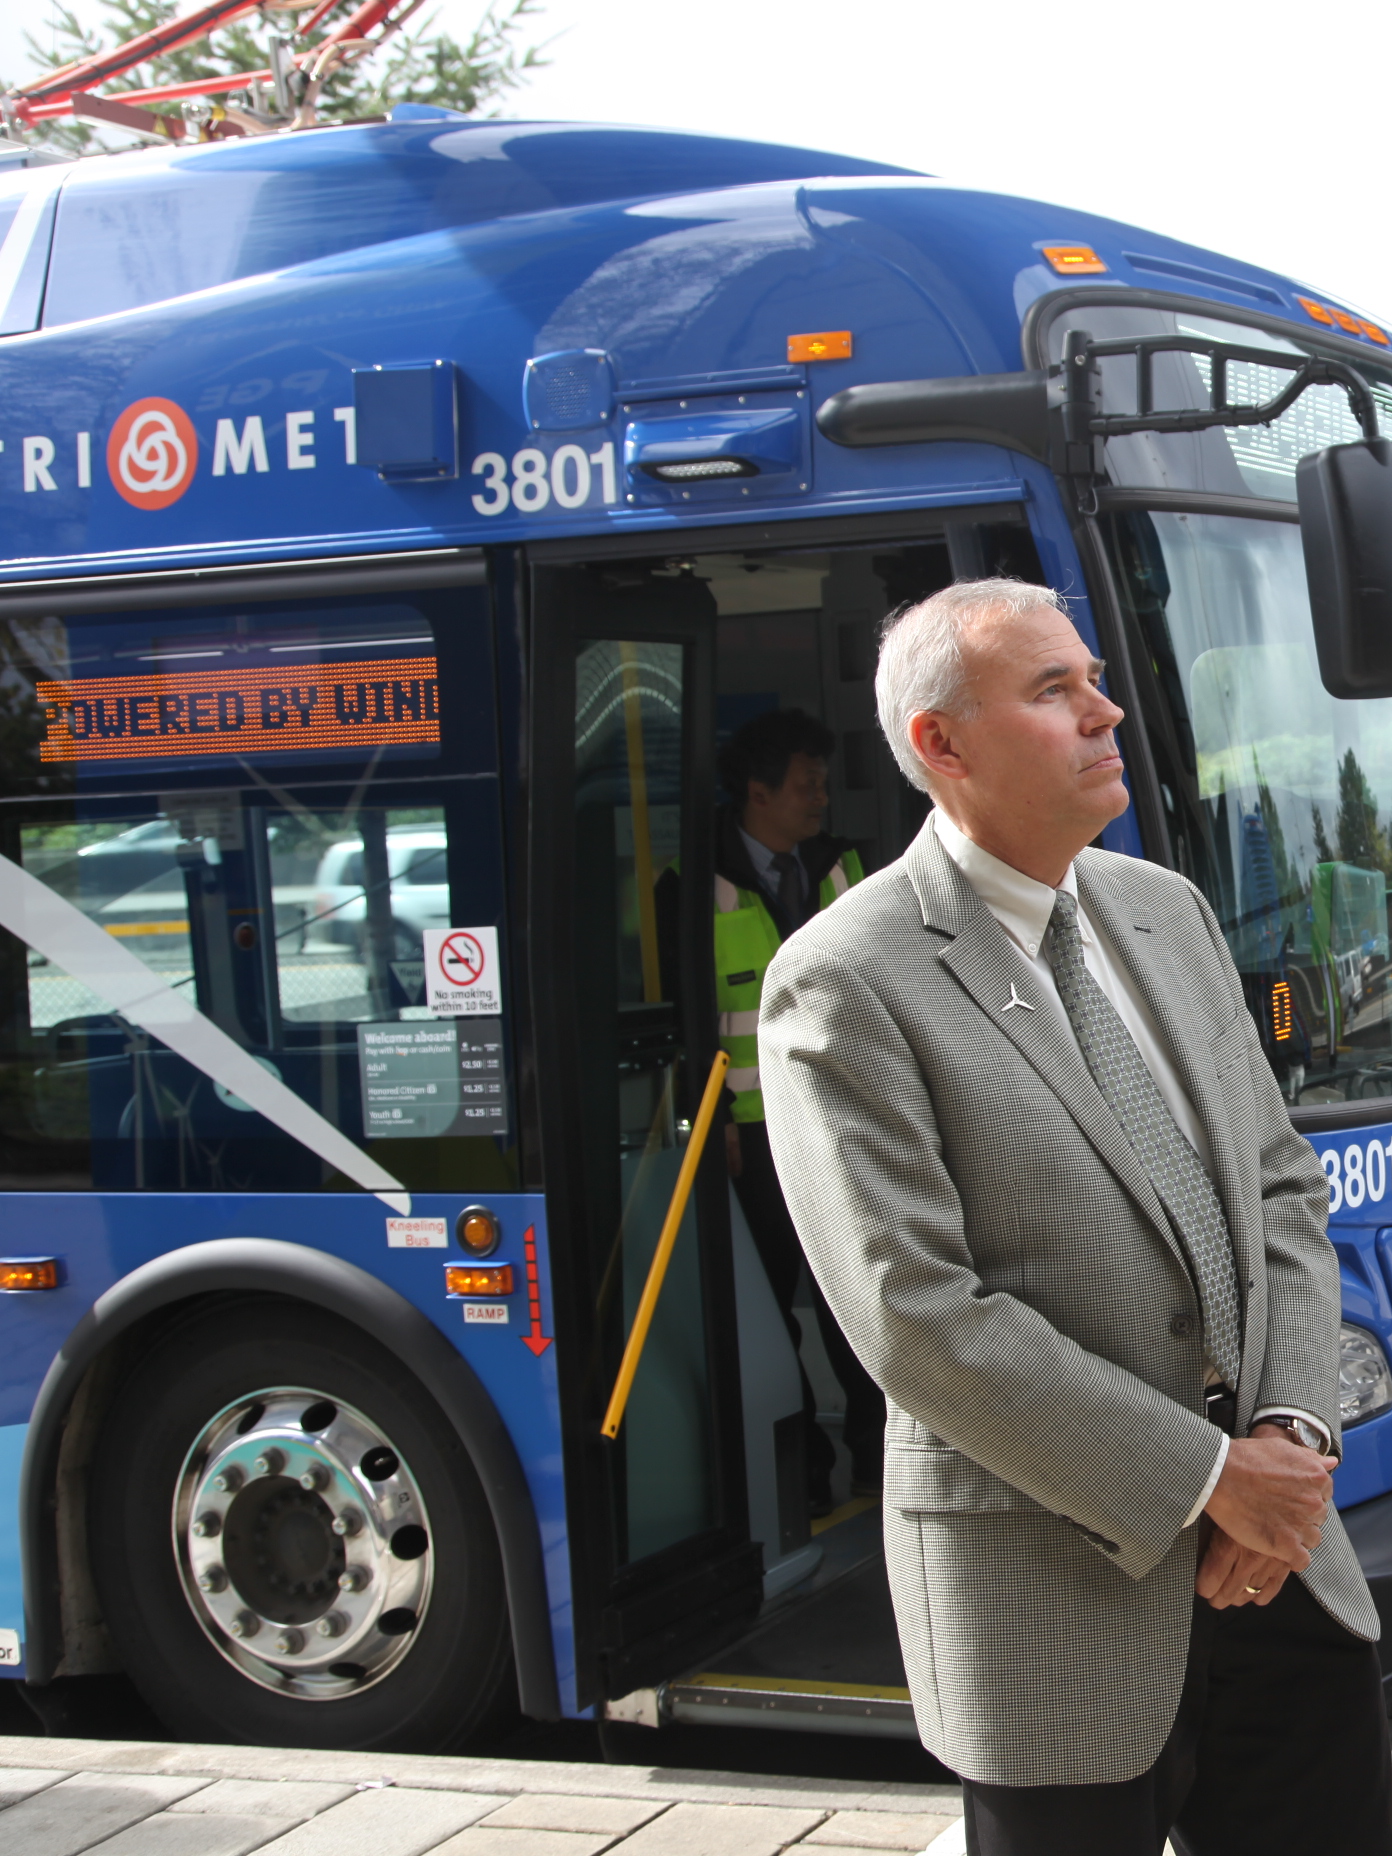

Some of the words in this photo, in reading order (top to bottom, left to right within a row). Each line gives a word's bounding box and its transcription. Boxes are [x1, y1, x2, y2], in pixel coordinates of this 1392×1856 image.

[0, 432, 92, 492] RI
[470, 442, 617, 517] 3801
[260, 684, 319, 728] BY
[434, 990, 448, 1000] No
[451, 988, 493, 1001] smoking
[431, 1002, 464, 1012] within
[465, 1001, 477, 1011] 10
[479, 1001, 499, 1011] feet
[364, 1032, 413, 1044] Welcome
[414, 1029, 457, 1042] aboard!
[366, 1063, 388, 1072] Adult
[367, 1086, 399, 1096] Honored
[400, 1085, 425, 1096] Citizen
[369, 1109, 391, 1120] Youth
[388, 1219, 445, 1235] Kneeling
[405, 1234, 431, 1247] Bus
[466, 1307, 506, 1320] RAMP
